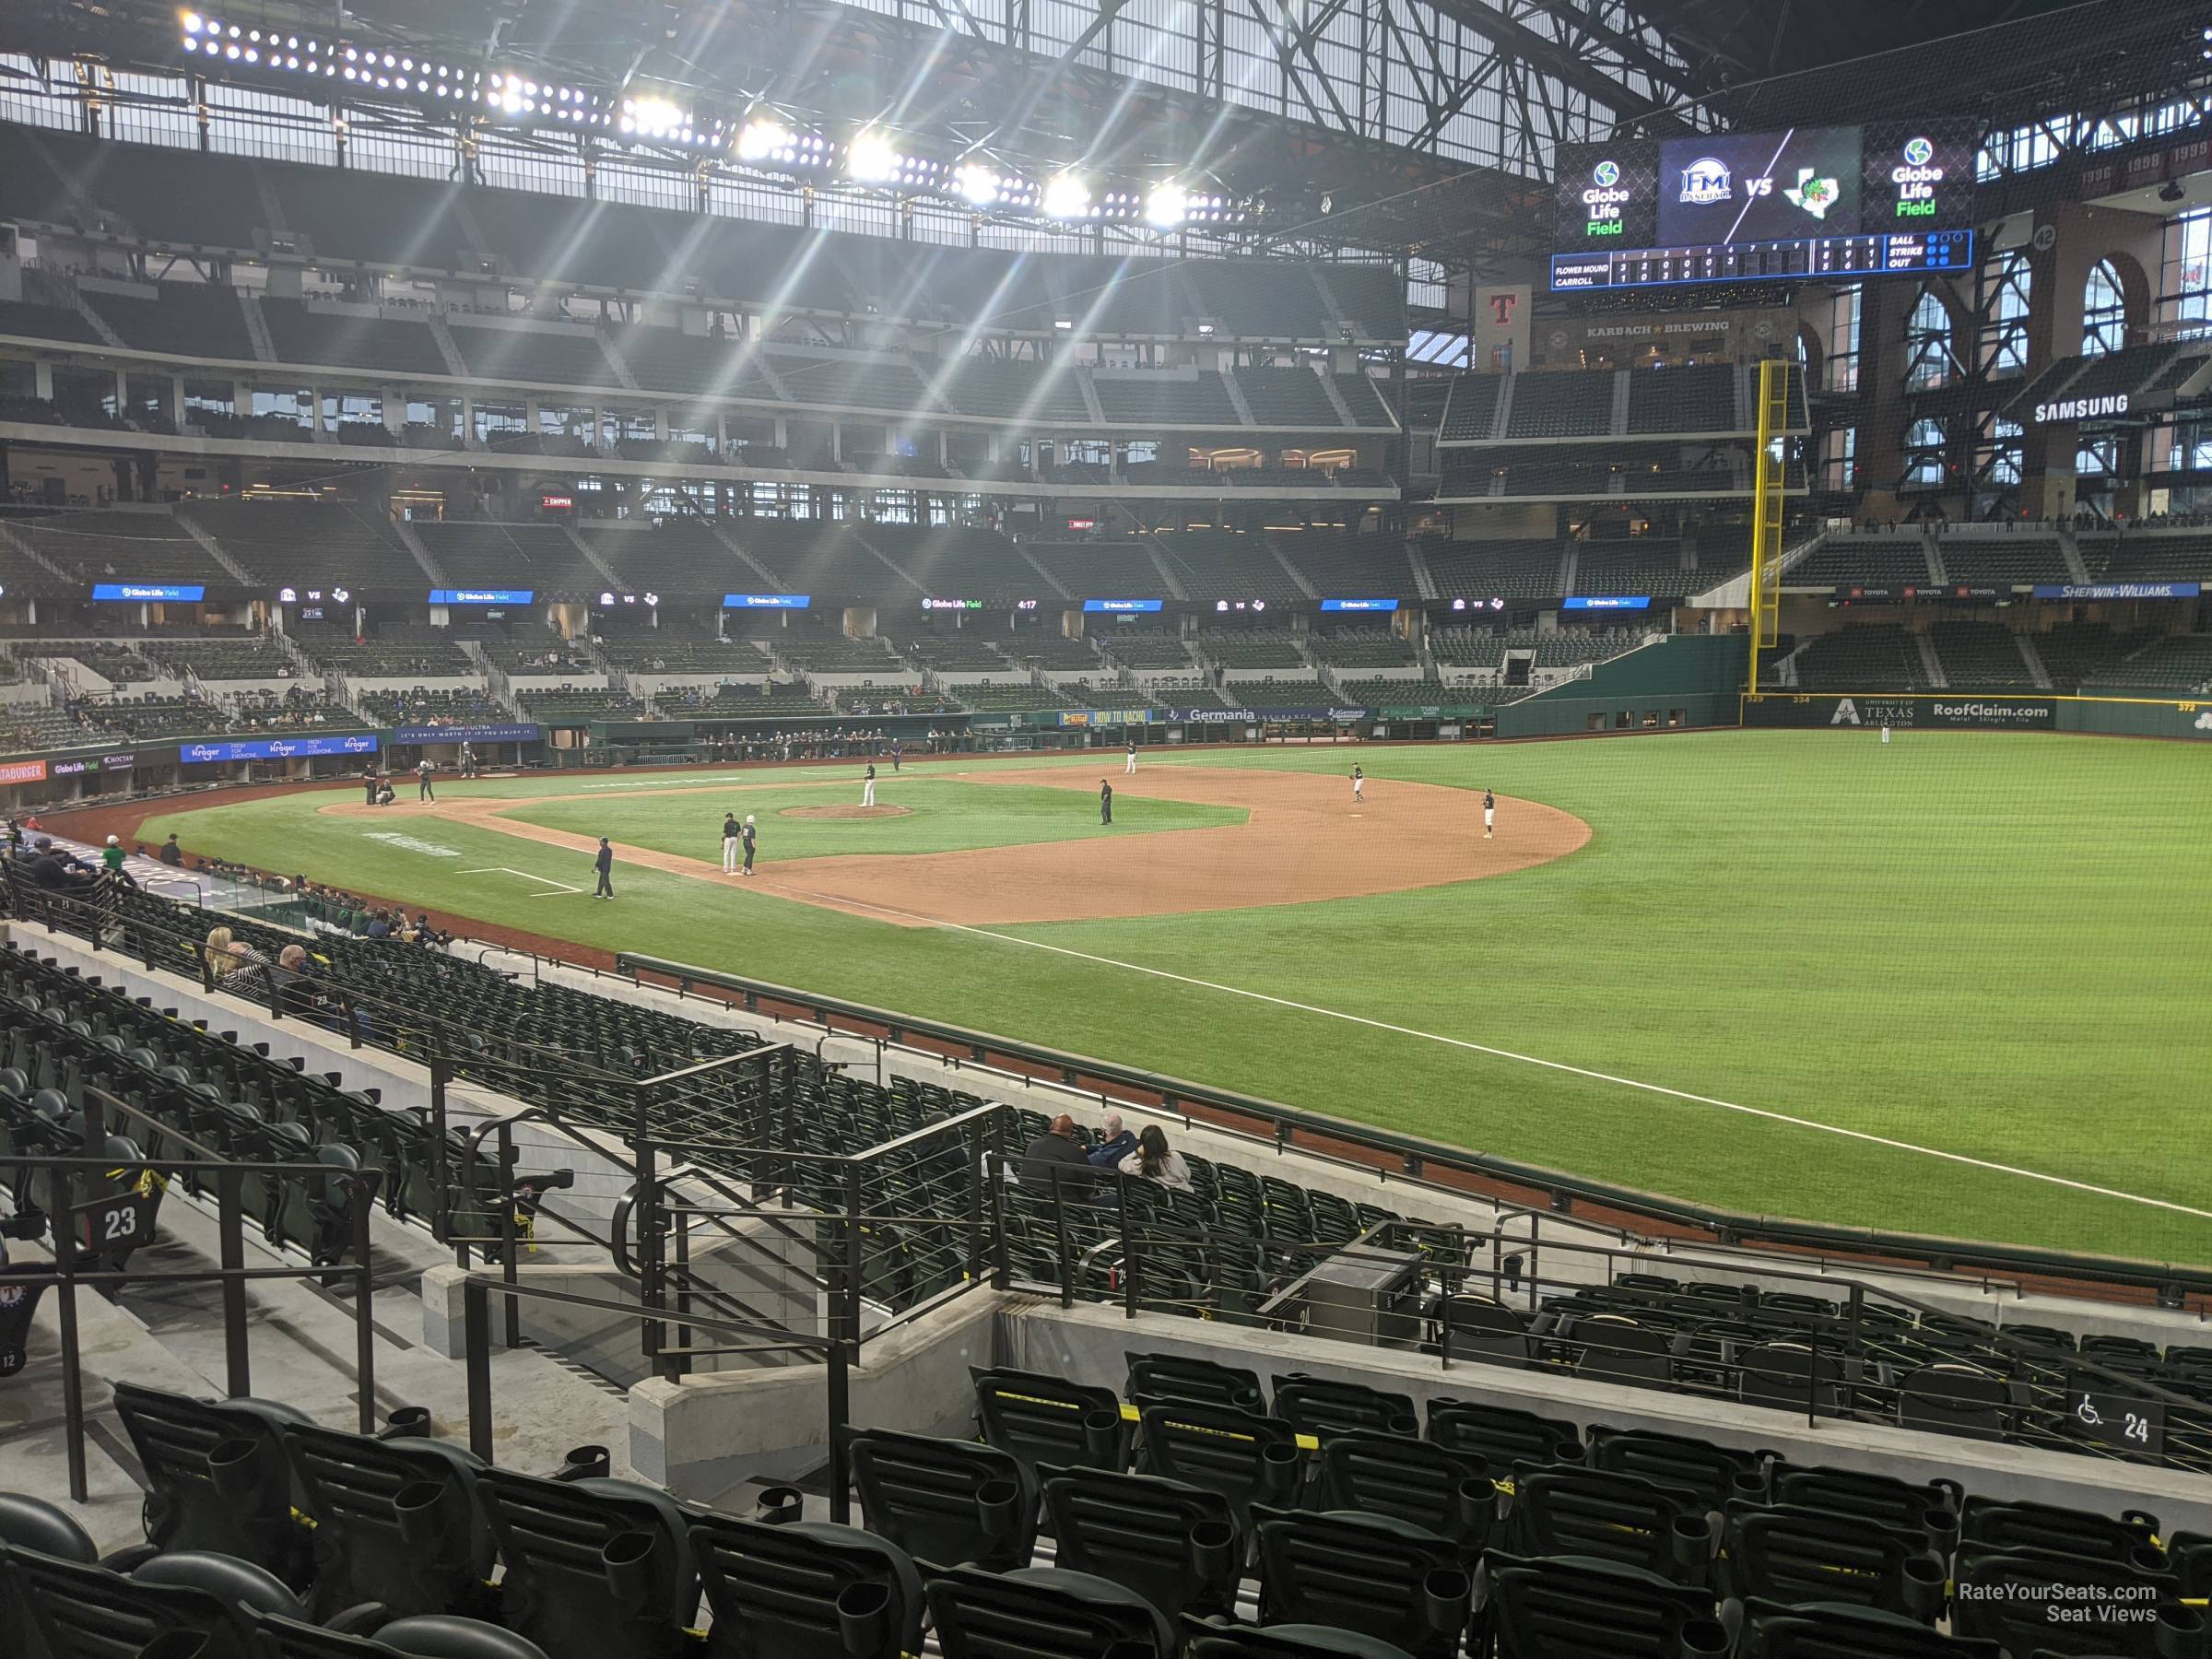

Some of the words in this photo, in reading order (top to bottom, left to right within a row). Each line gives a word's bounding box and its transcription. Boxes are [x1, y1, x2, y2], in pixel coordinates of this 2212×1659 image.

[2174, 142, 2208, 161] 1999
[2127, 153, 2159, 172] 1998
[1683, 171, 1730, 191] FM
[1891, 166, 1943, 182] Globe
[1583, 188, 1630, 204] Globe
[1679, 190, 1732, 203] BASEBALL
[1900, 183, 1933, 199] Life
[1591, 205, 1619, 219] Life
[1897, 199, 1936, 217] Field
[1587, 219, 1623, 235] Field
[1889, 236, 1914, 245] BALL
[2035, 229, 2053, 245] 42
[1889, 246, 1923, 256] STRIKE
[1556, 266, 1583, 275] FLOWER
[1583, 265, 1608, 274] MOUND
[1889, 258, 1912, 267] OUT
[1556, 277, 1594, 287] CARROLL
[1822, 263, 1829, 271] 5
[1490, 294, 1518, 324] T
[1587, 326, 1652, 337] KARBACH
[1665, 322, 1729, 334] BREWING
[2035, 394, 2128, 422] SAMSUNG
[932, 600, 952, 608] Globe
[953, 600, 966, 608] Life
[966, 600, 982, 608] Field
[1190, 709, 1255, 720] Germania
[1830, 699, 1861, 724] A
[1865, 707, 1914, 718] TEXAS
[1934, 703, 2049, 717] RoofClaim.com
[2178, 703, 2196, 712] 372
[1095, 712, 1112, 723] HOW
[1113, 712, 1121, 723] TO
[1123, 711, 1146, 723] NACHO
[269, 741, 295, 756] Kroger
[345, 737, 369, 752] Kroger
[107, 754, 135, 764] CHOCTAW
[192, 745, 220, 761] Kroger
[0, 766, 41, 781] TABURGER
[55, 764, 73, 774] Globe
[74, 762, 85, 772] Life
[85, 760, 99, 771] Field
[317, 995, 327, 1005] 23
[105, 1206, 136, 1240] 23
[1300, 1306, 1311, 1332] 24
[4, 1355, 16, 1368] 12
[2124, 1413, 2148, 1442] 24
